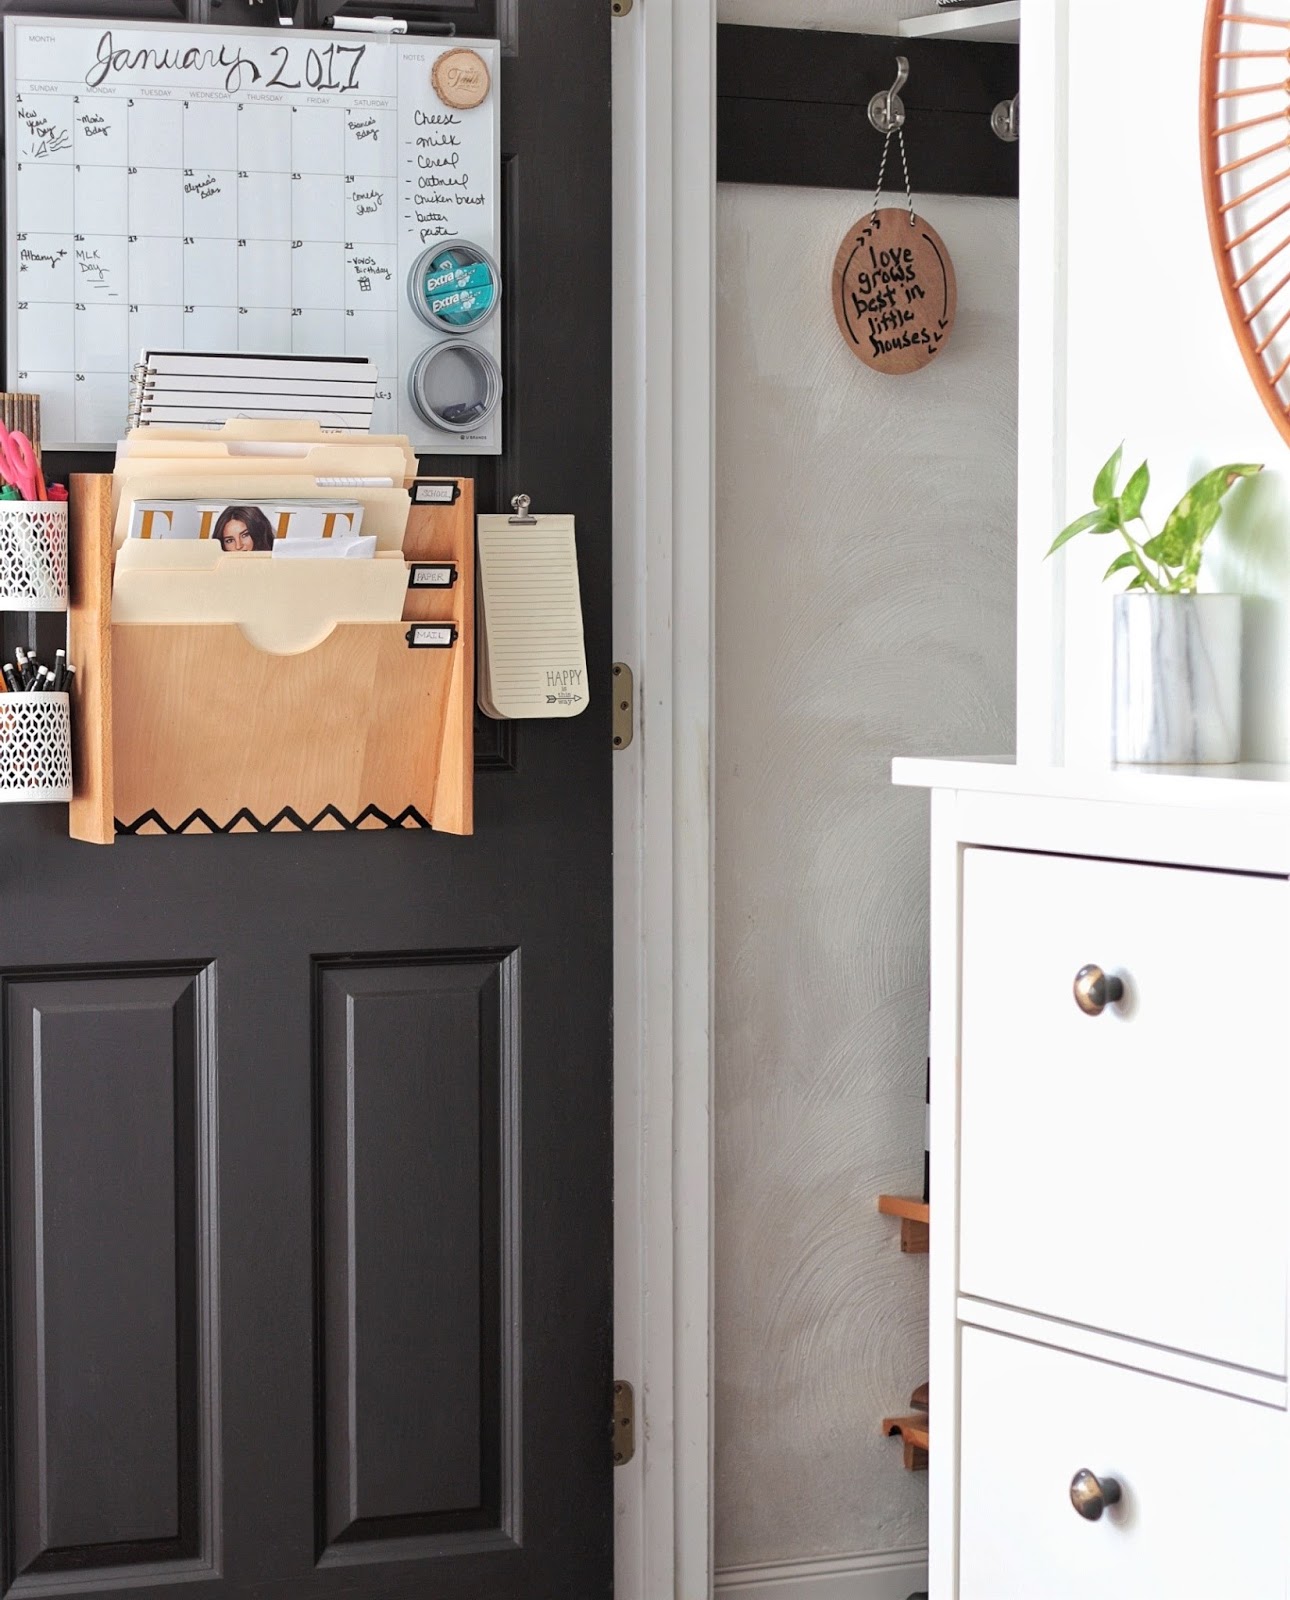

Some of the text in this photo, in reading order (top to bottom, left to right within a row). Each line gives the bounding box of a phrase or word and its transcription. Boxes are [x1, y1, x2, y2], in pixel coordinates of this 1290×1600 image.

[28, 35, 56, 43] MONTH
[85, 31, 366, 93] January 2017
[402, 54, 425, 62] NOTES
[29, 84, 59, 93] SUNDAY
[86, 87, 117, 95] MONDAY
[140, 88, 172, 97] TUESDAY
[16, 93, 23, 103] 1
[73, 95, 80, 104] 2
[189, 91, 232, 100] WEDNESDAY
[246, 94, 283, 102] THURSDAY
[127, 98, 135, 108] 3
[183, 100, 189, 109] 4
[306, 97, 330, 105] FRIDAY
[353, 99, 389, 107] SATURDAY
[237, 103, 244, 111] 5
[18, 107, 37, 118] New
[75, 164, 81, 172] 9
[127, 167, 138, 175] 10
[183, 168, 194, 177] 11
[237, 170, 249, 178] 12
[415, 210, 448, 222] butter
[16, 233, 28, 241] 15
[73, 234, 85, 242] 16
[128, 235, 138, 243] 17
[420, 226, 458, 244] pasta
[183, 236, 195, 245] 18
[237, 238, 247, 247] 19
[344, 242, 354, 250] 21
[75, 249, 100, 260] MLK
[868, 246, 914, 269] love
[79, 262, 110, 280] Day
[354, 265, 393, 280] Birthday
[427, 271, 455, 292] Extra
[858, 264, 916, 295] grows
[17, 301, 28, 310] 22
[75, 302, 86, 311] 23
[432, 293, 460, 313] Extra
[851, 284, 925, 320] best in
[129, 304, 138, 313] 24
[238, 306, 248, 315] 26
[291, 307, 303, 317] 27
[867, 309, 914, 336] little
[416, 573, 445, 582] PAPER
[416, 631, 444, 640] MAIL
[546, 669, 582, 687] HAPPY
